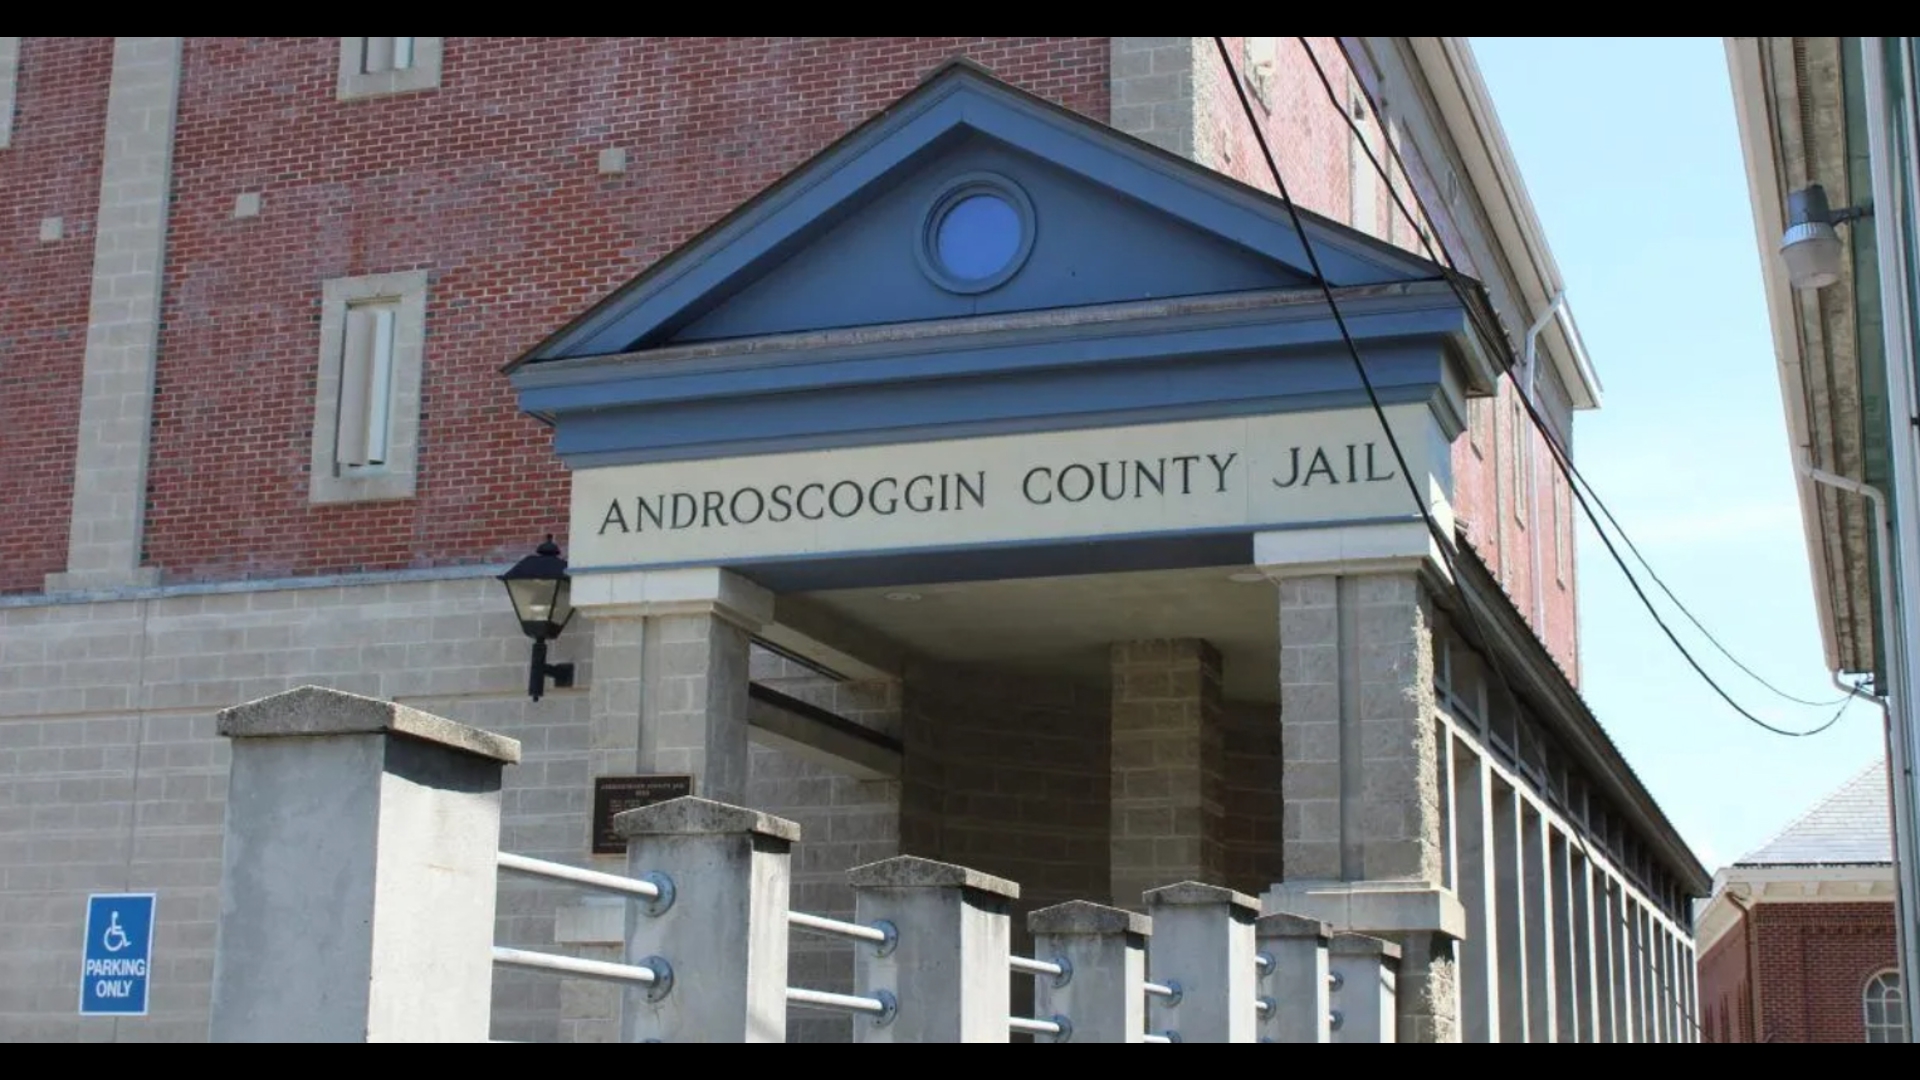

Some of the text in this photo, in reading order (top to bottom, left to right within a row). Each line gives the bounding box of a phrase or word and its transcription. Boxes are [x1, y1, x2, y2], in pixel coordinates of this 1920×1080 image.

[597, 443, 1395, 535] ANDROSCOGGIN COUNTY JAIL
[86, 959, 146, 976] PARKING
[95, 979, 133, 998] ONLY
